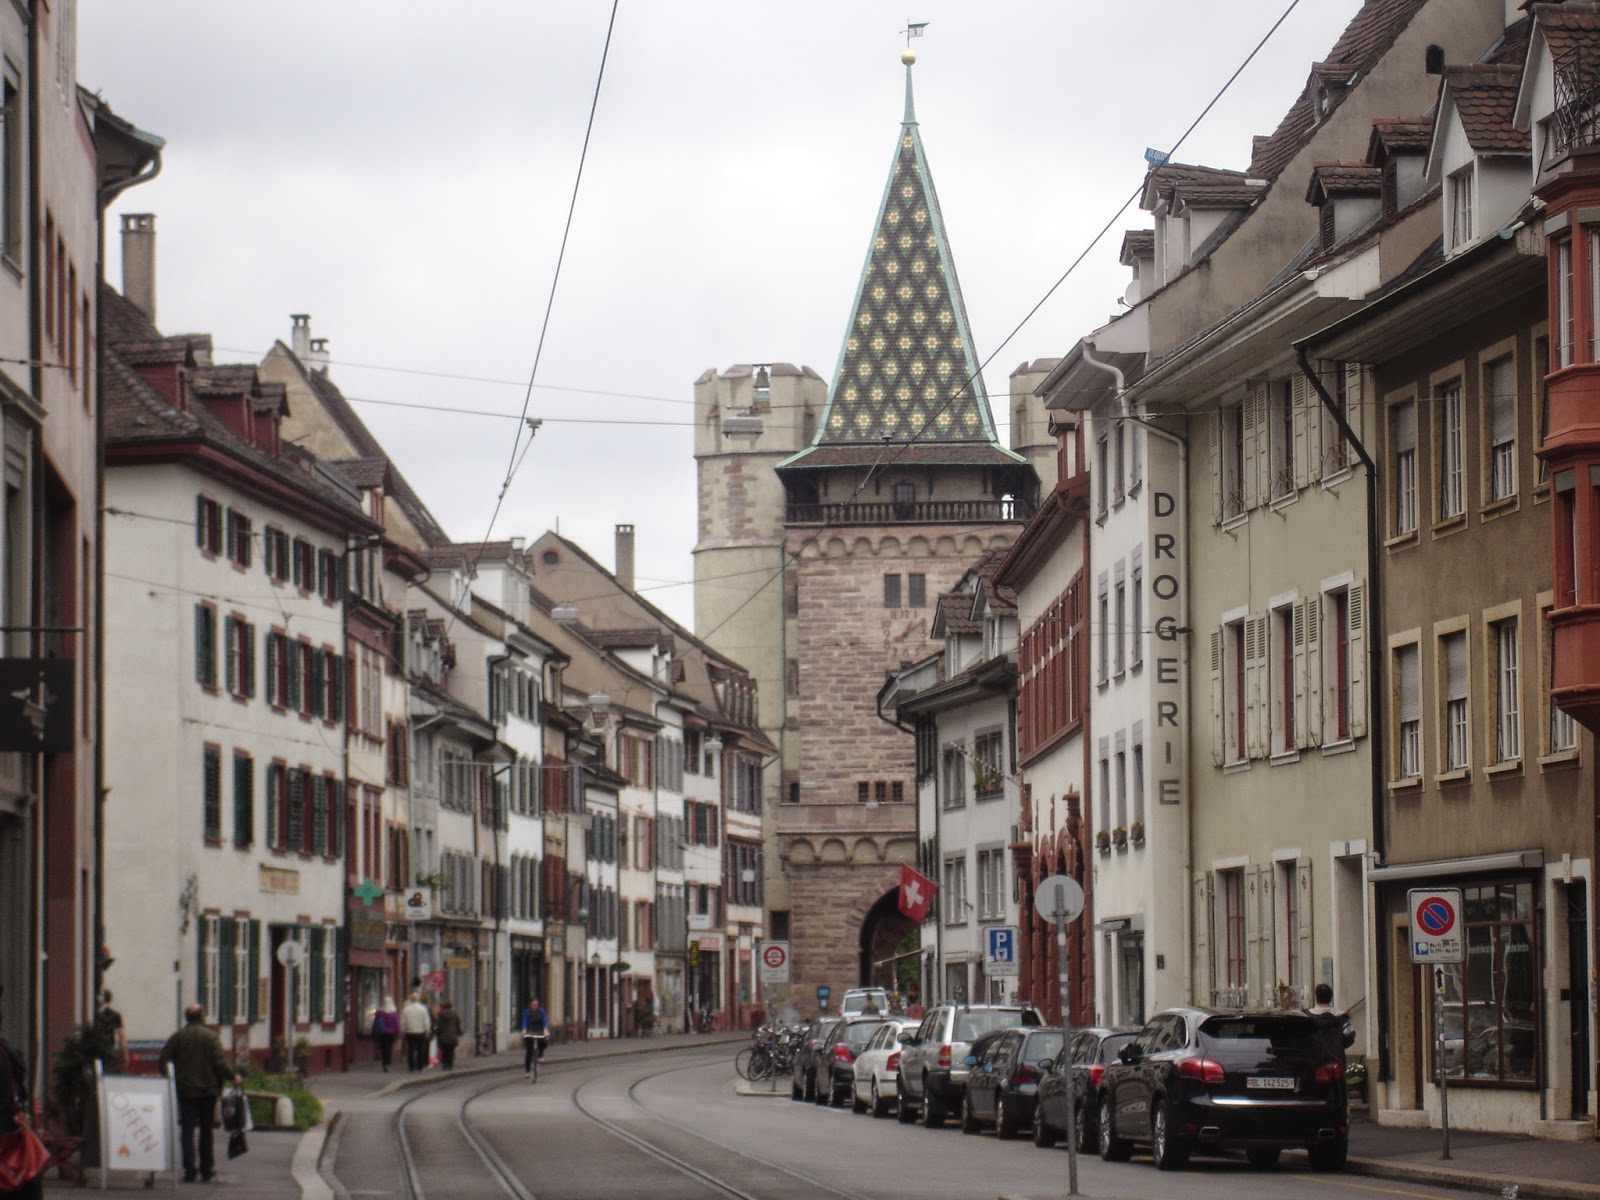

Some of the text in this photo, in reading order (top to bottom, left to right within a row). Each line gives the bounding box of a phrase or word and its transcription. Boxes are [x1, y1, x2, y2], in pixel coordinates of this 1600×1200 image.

[1152, 491, 1181, 806] DROGERIE
[996, 932, 1007, 948] P
[111, 1094, 161, 1153] OFFEN
